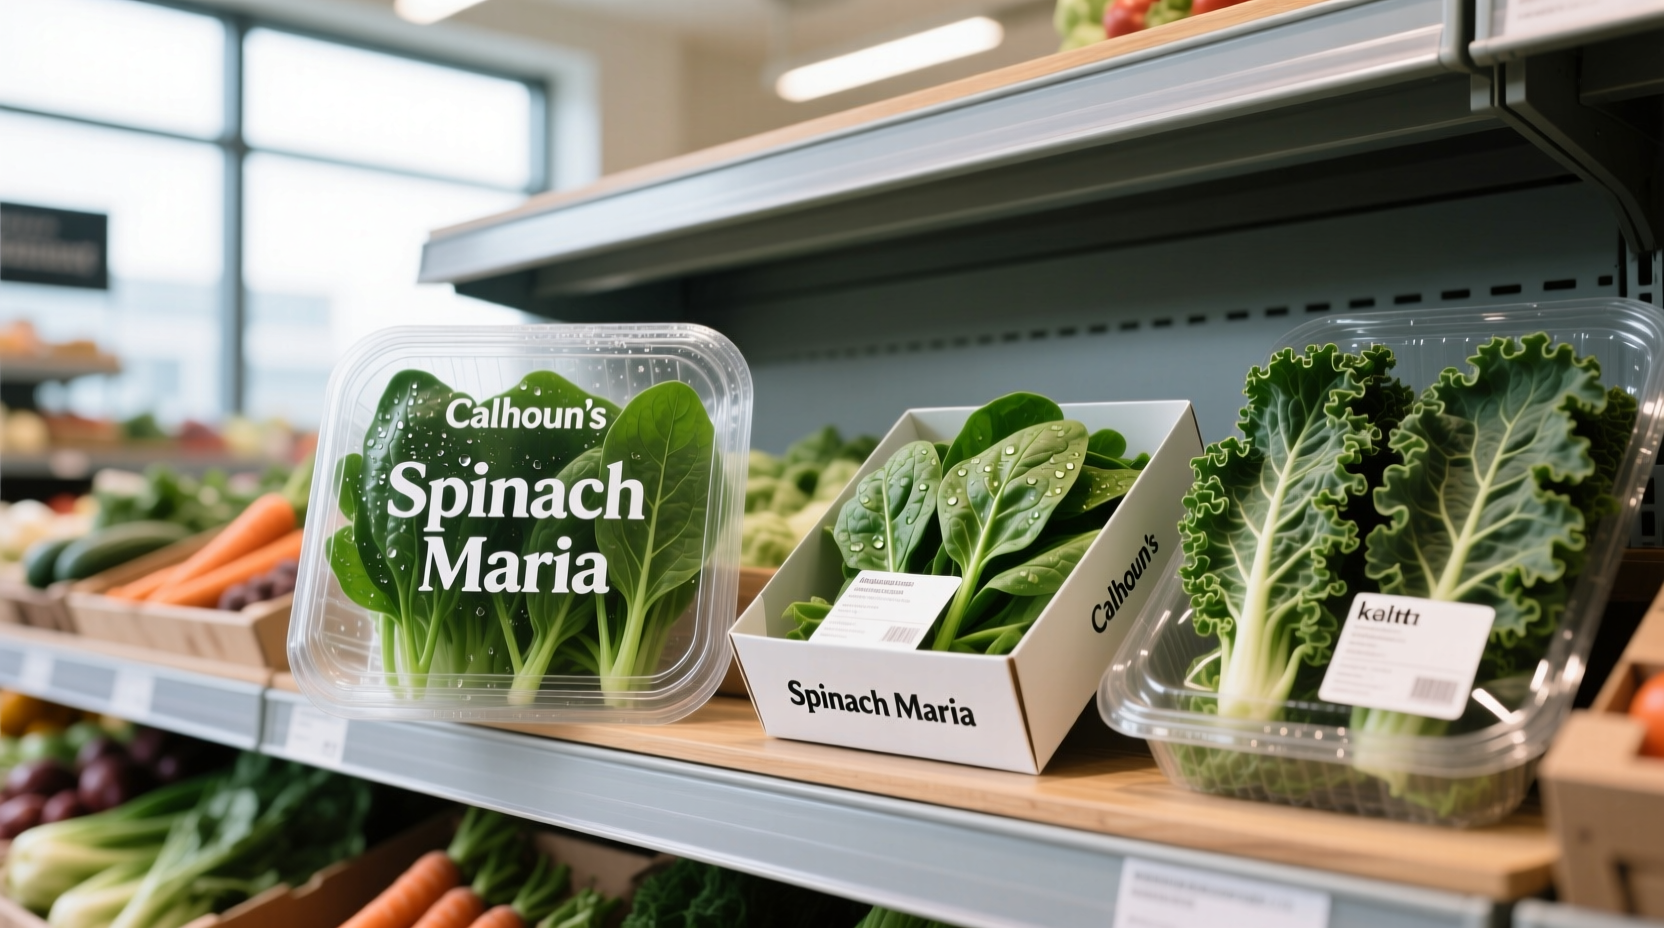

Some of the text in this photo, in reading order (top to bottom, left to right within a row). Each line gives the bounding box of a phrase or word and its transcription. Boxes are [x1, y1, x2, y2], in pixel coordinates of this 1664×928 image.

[446, 397, 607, 429] Calhoun’s
[387, 460, 645, 532] Spinach
[418, 536, 610, 594] Maria
[1091, 533, 1159, 634] Calhoun’s
[787, 680, 977, 727] Spinach Maria
